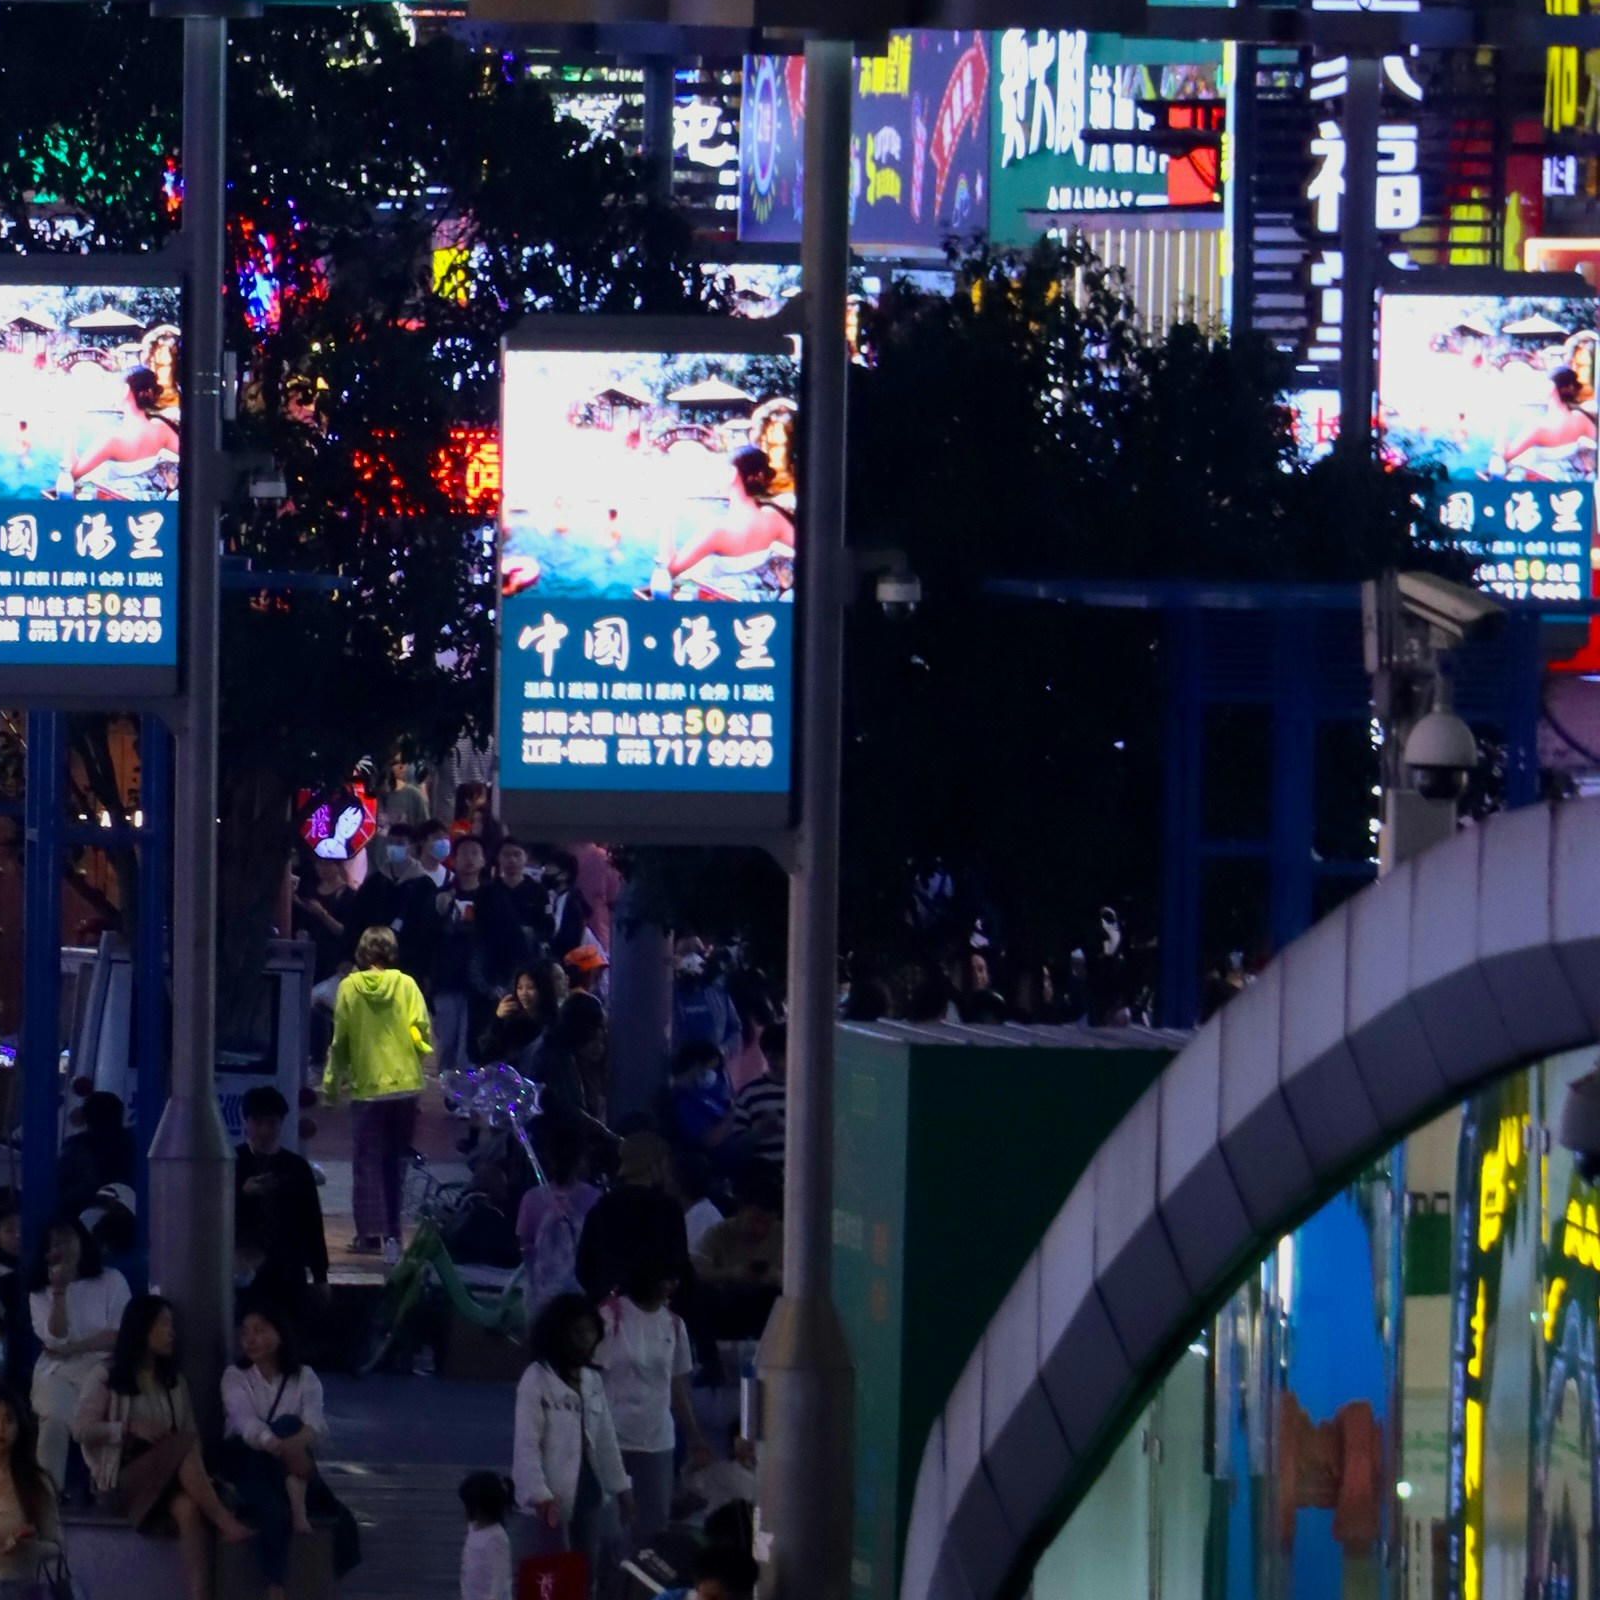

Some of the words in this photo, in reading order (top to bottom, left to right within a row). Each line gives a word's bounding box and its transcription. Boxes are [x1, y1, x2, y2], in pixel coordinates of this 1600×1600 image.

[60, 619, 102, 643] 717
[106, 619, 163, 644] 9999
[653, 738, 703, 766] 717
[706, 738, 774, 767] 9999
